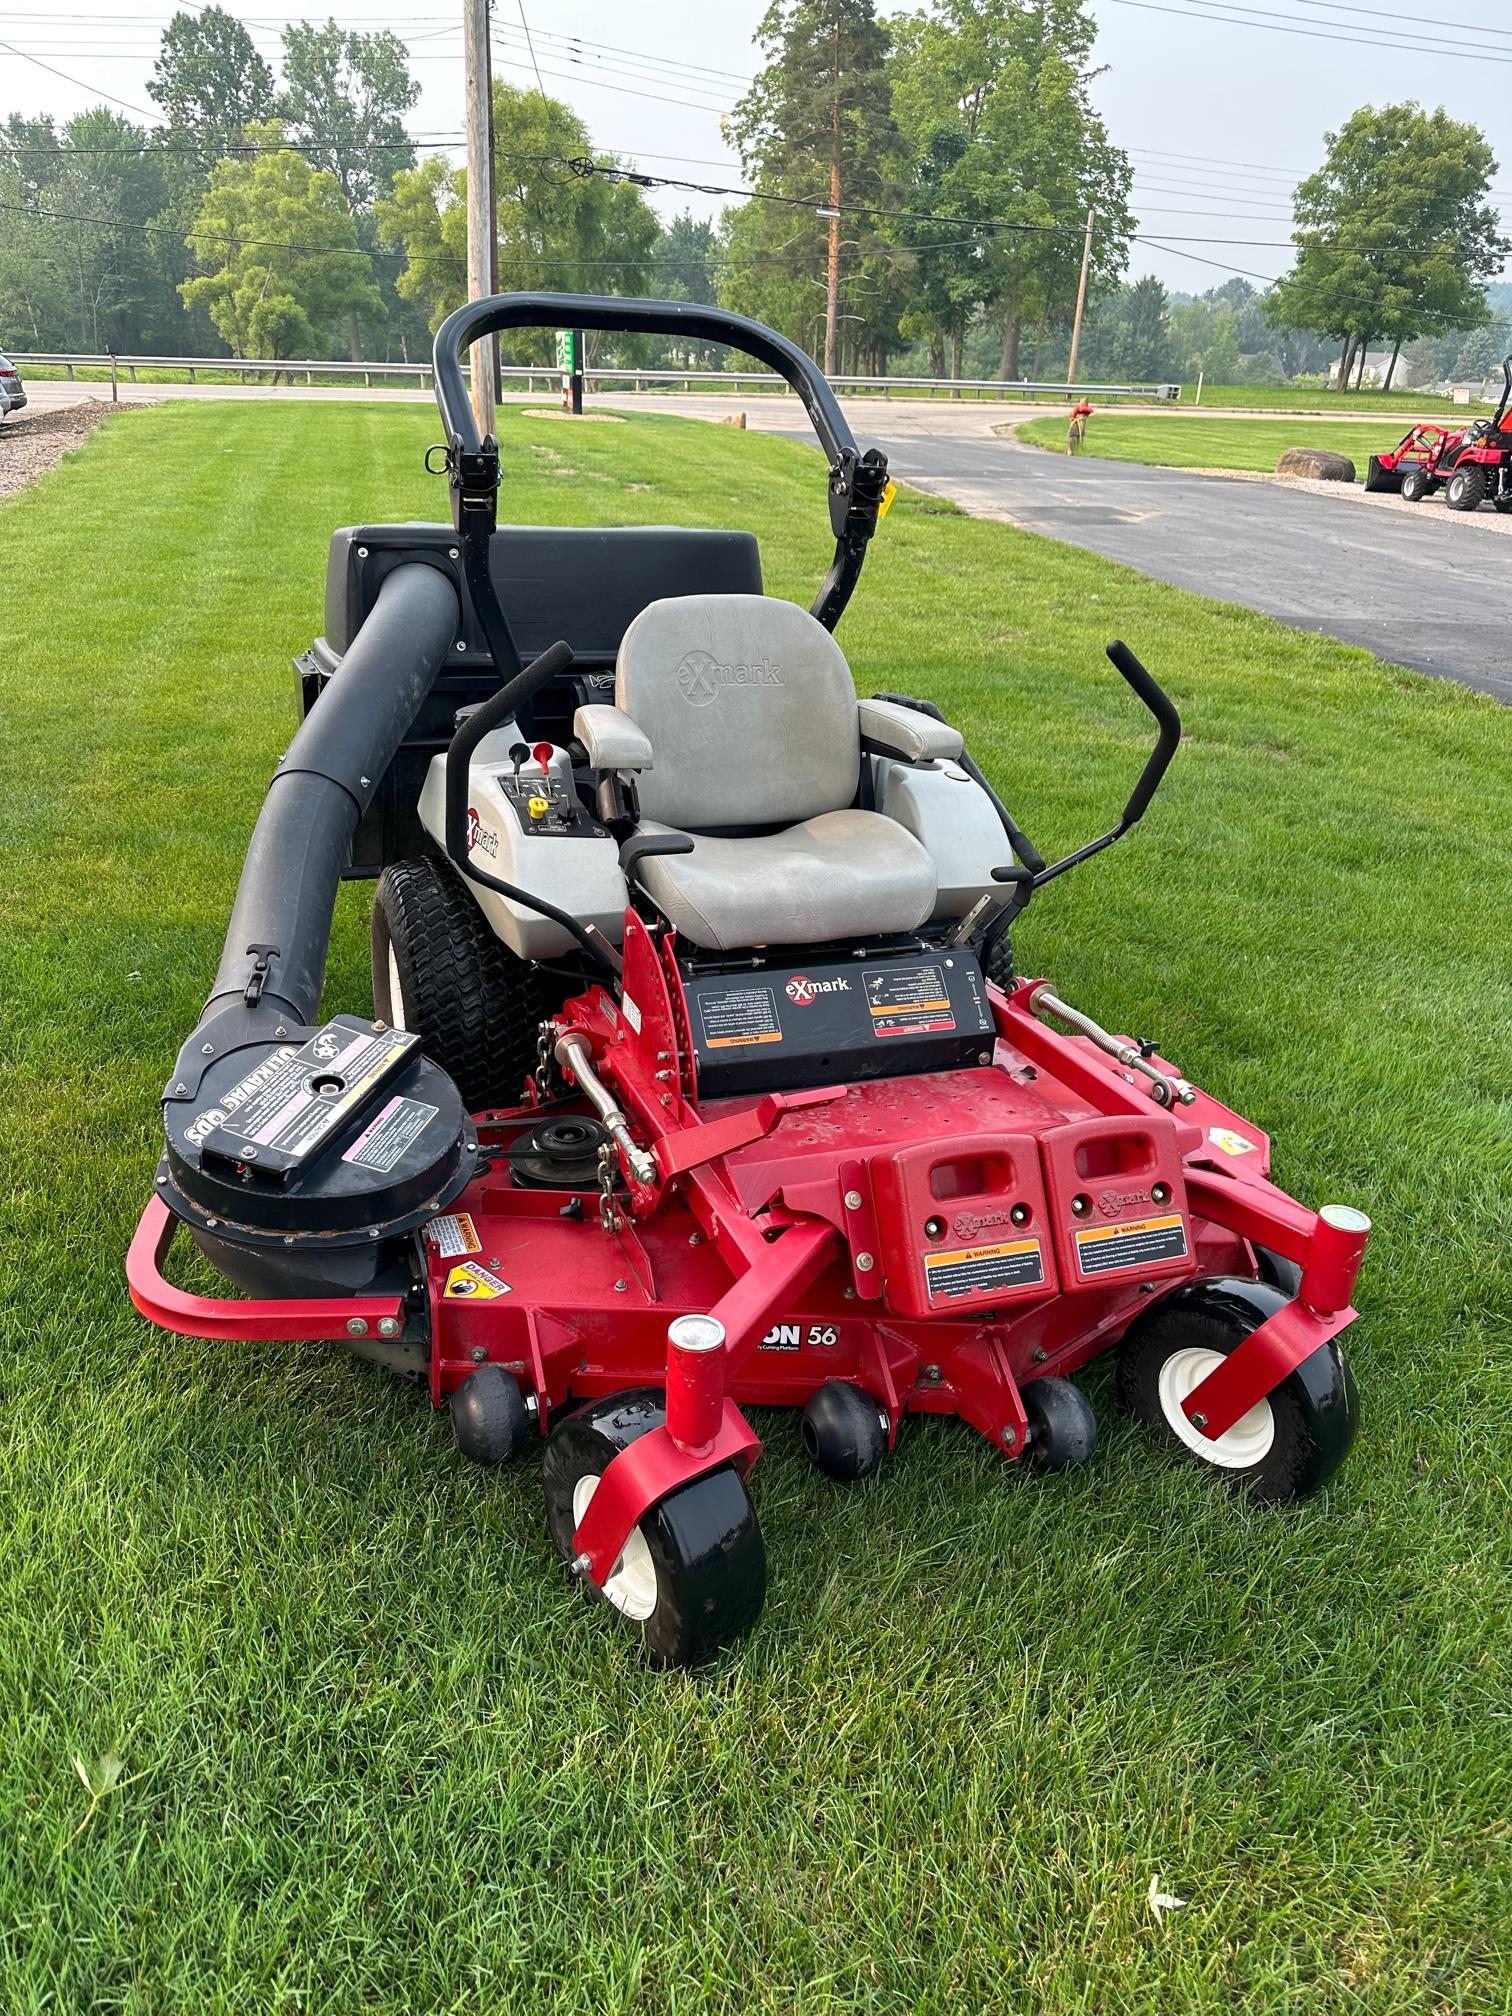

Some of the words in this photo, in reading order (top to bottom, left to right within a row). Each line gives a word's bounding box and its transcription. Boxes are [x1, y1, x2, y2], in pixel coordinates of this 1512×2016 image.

[467, 813, 499, 858] Xmark
[785, 977, 850, 1001] eXmark
[460, 1222, 476, 1250] WARNING
[1120, 1223, 1146, 1233] WARNING
[973, 1247, 1001, 1258] WARNING
[465, 1263, 507, 1291] DANGER
[807, 1326, 837, 1346] 56
